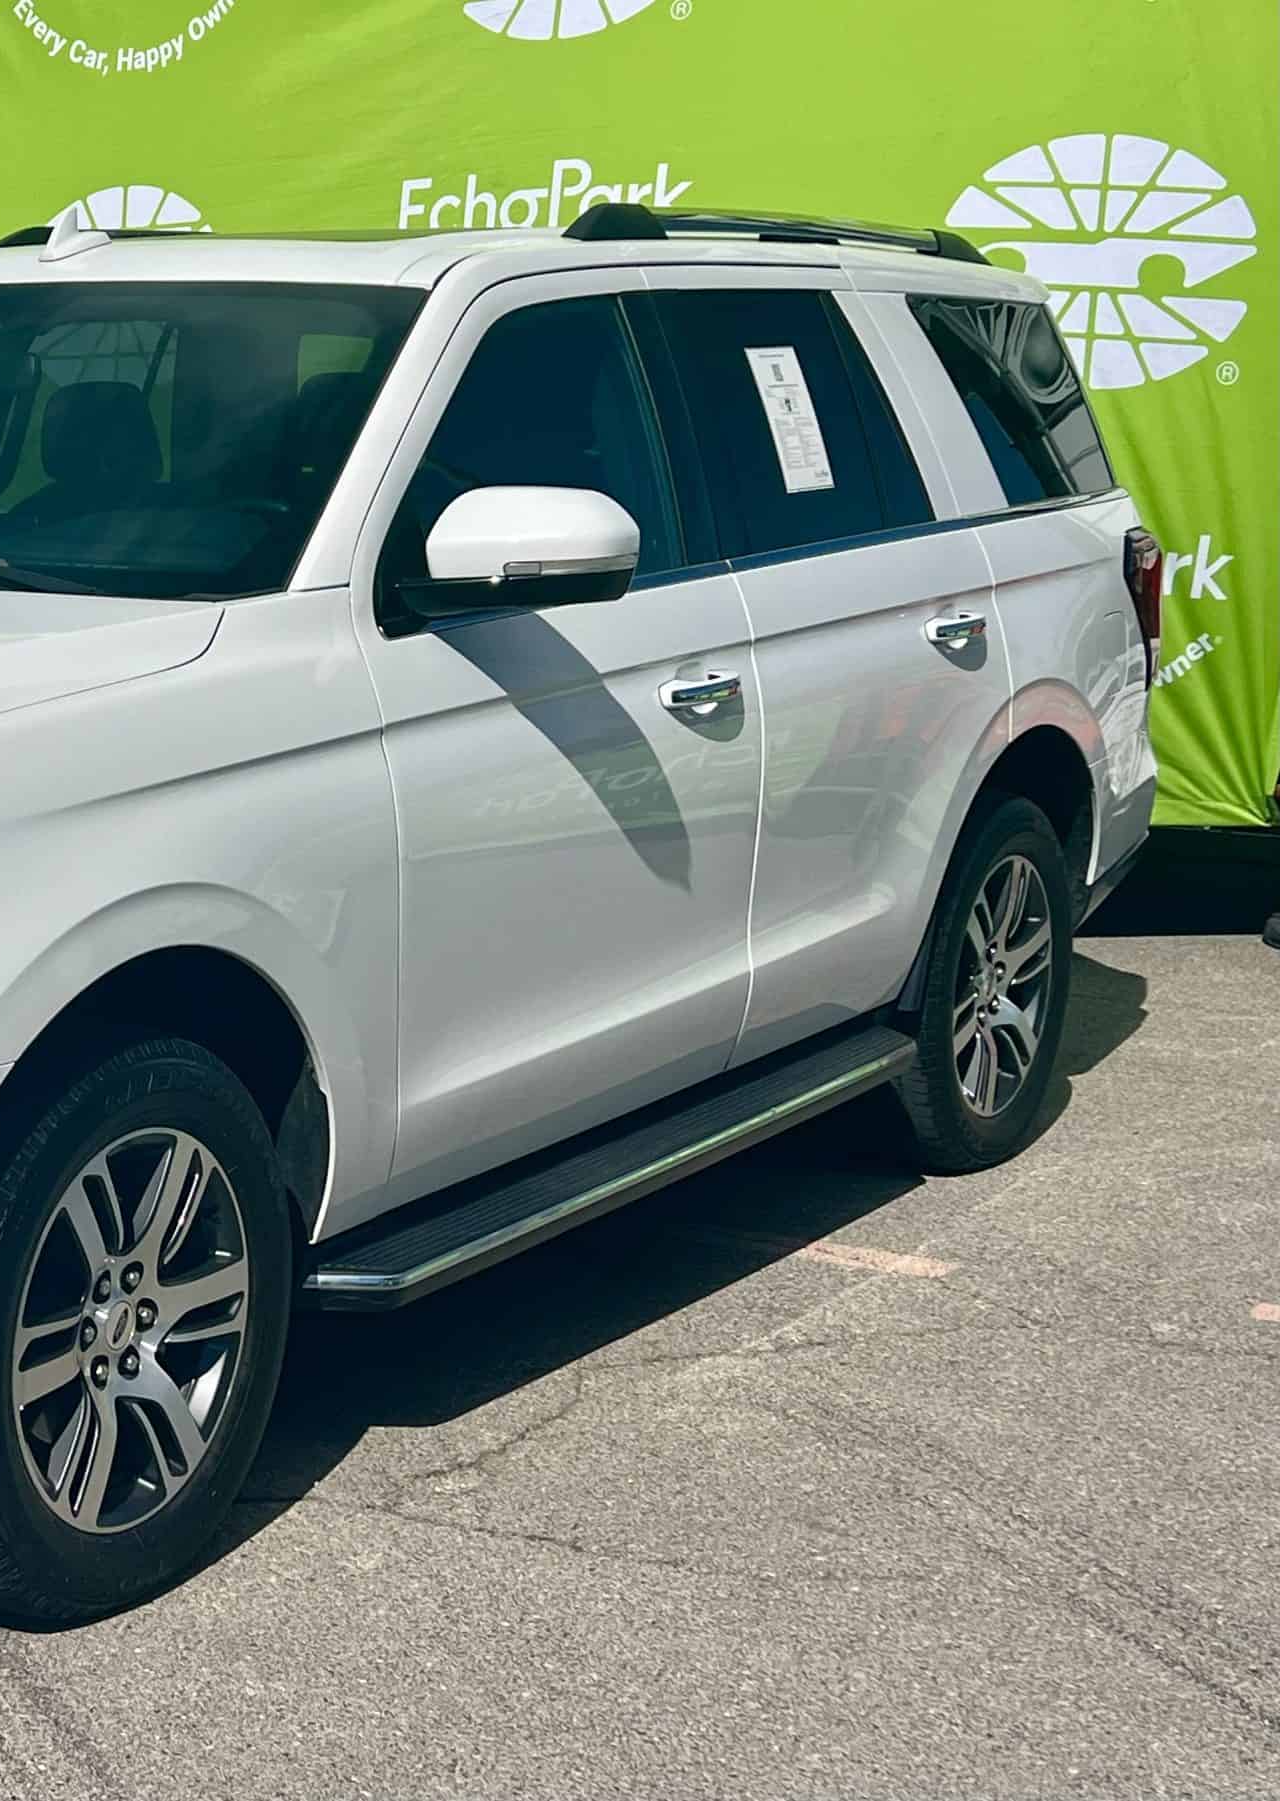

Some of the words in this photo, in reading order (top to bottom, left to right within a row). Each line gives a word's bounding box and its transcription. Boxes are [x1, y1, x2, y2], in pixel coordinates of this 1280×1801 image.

[14, 0, 67, 56] Every
[69, 39, 108, 76] Car,
[116, 34, 183, 72] Happy
